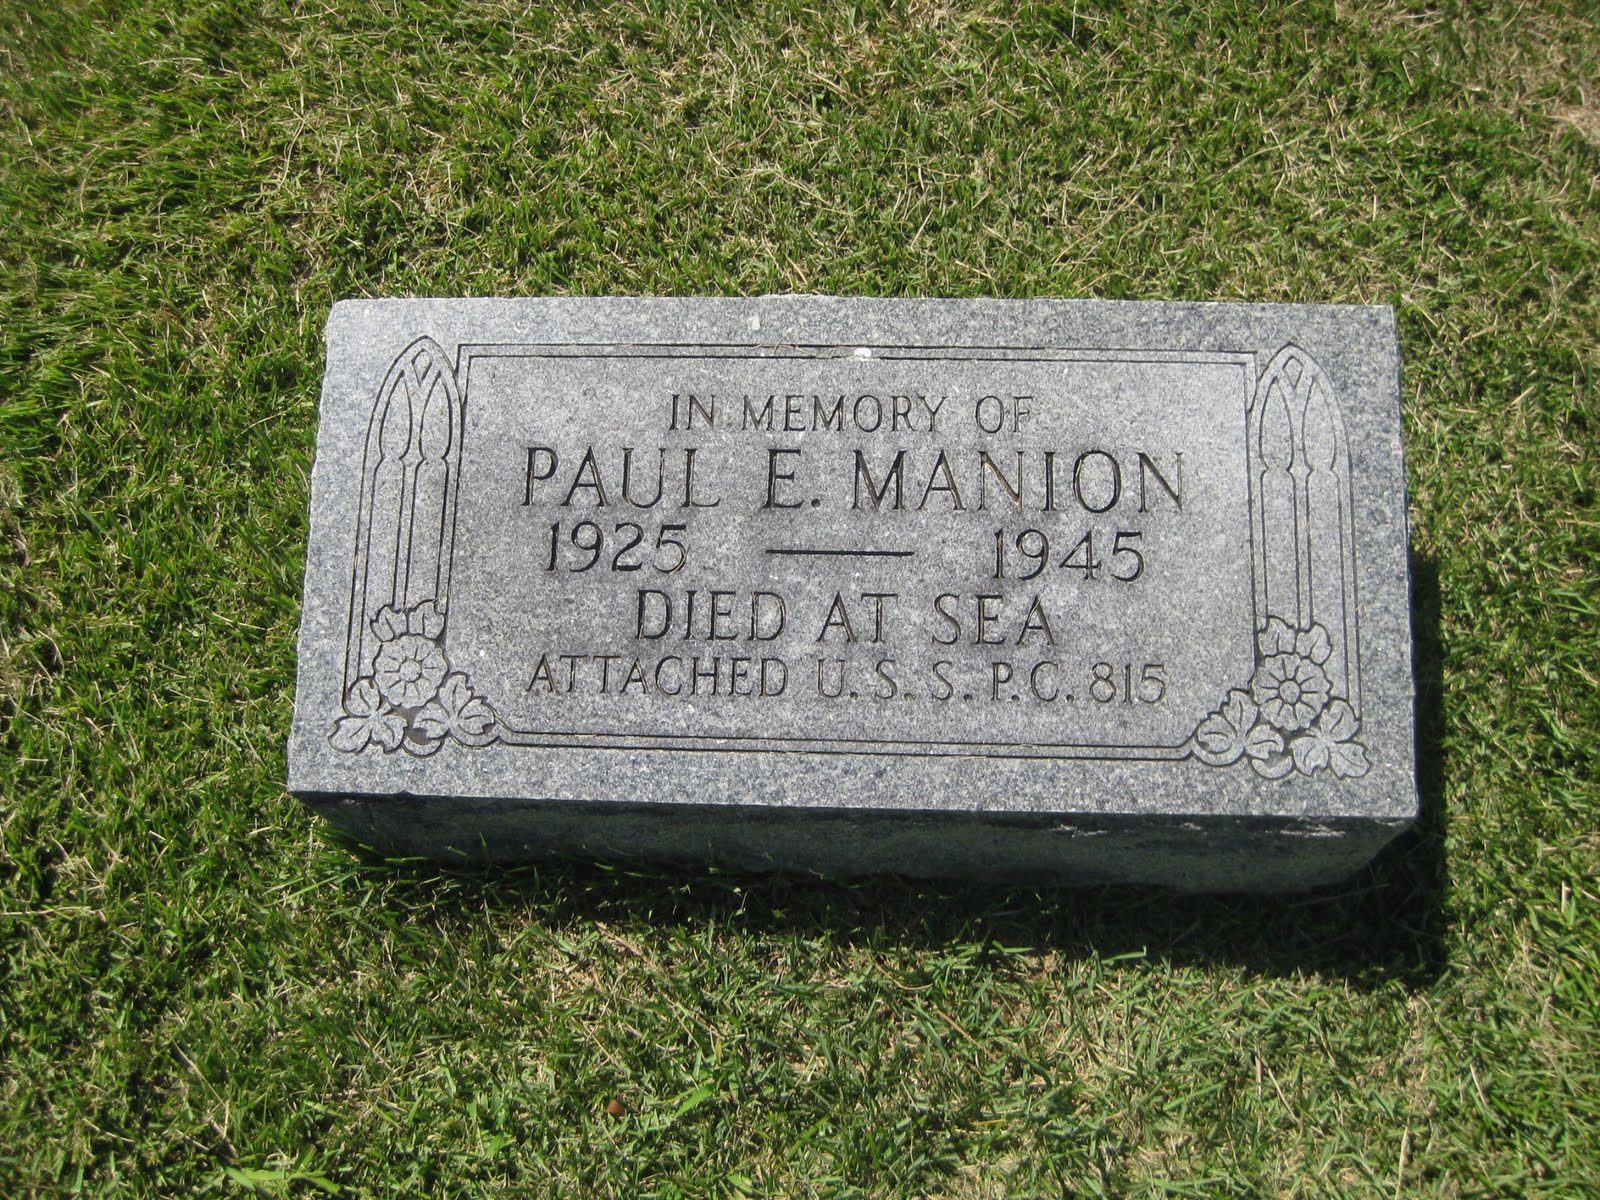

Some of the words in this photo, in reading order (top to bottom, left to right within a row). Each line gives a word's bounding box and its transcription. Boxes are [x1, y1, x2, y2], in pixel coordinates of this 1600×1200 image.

[668, 393, 717, 431] IN
[741, 394, 949, 433] MEMORY
[975, 395, 1034, 434] OF
[521, 445, 721, 509] PAUL
[761, 448, 822, 509] E.
[851, 448, 1185, 514] MANION
[545, 520, 691, 574] 1925
[992, 528, 1145, 582] 1945
[634, 589, 787, 642] DIED
[815, 591, 899, 644] AT
[931, 594, 1058, 647] SEA
[525, 652, 789, 698] ATTACHED
